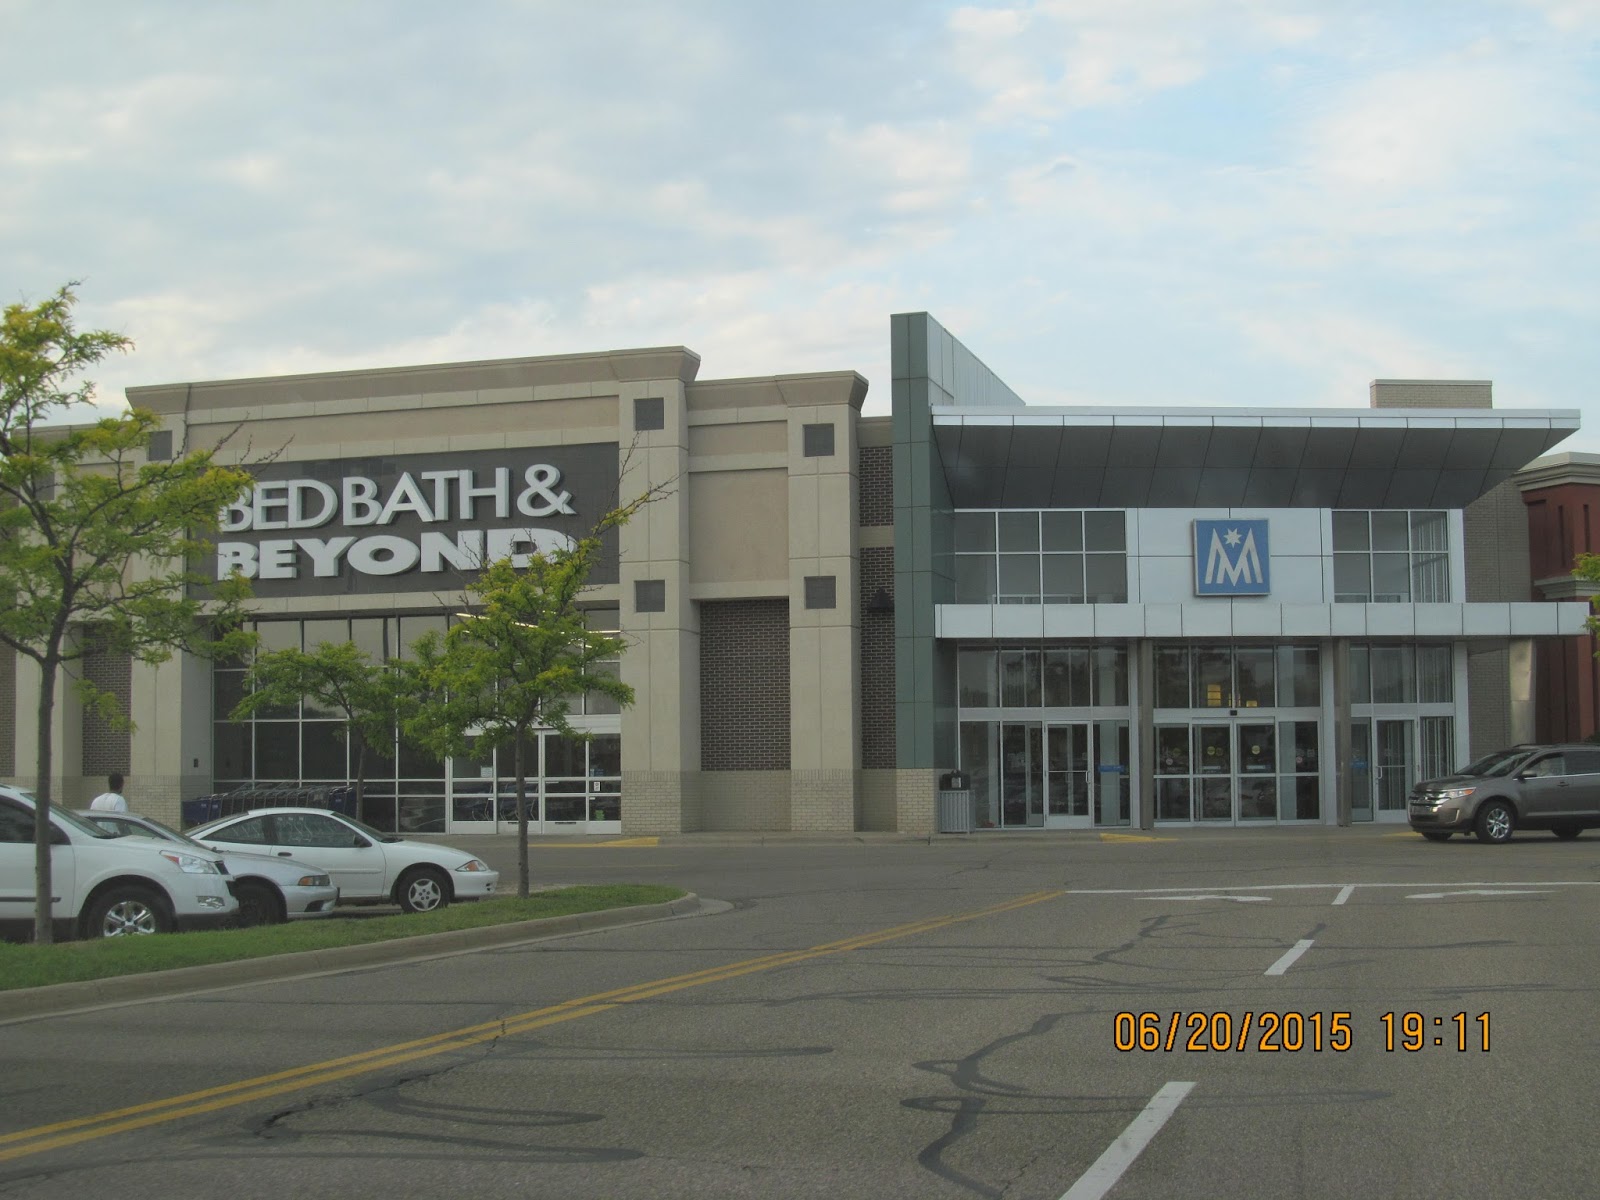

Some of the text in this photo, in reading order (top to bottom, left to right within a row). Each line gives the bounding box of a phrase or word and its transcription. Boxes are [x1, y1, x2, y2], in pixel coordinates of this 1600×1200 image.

[218, 464, 578, 532] BED BATH &
[217, 528, 578, 580] BEYOND
